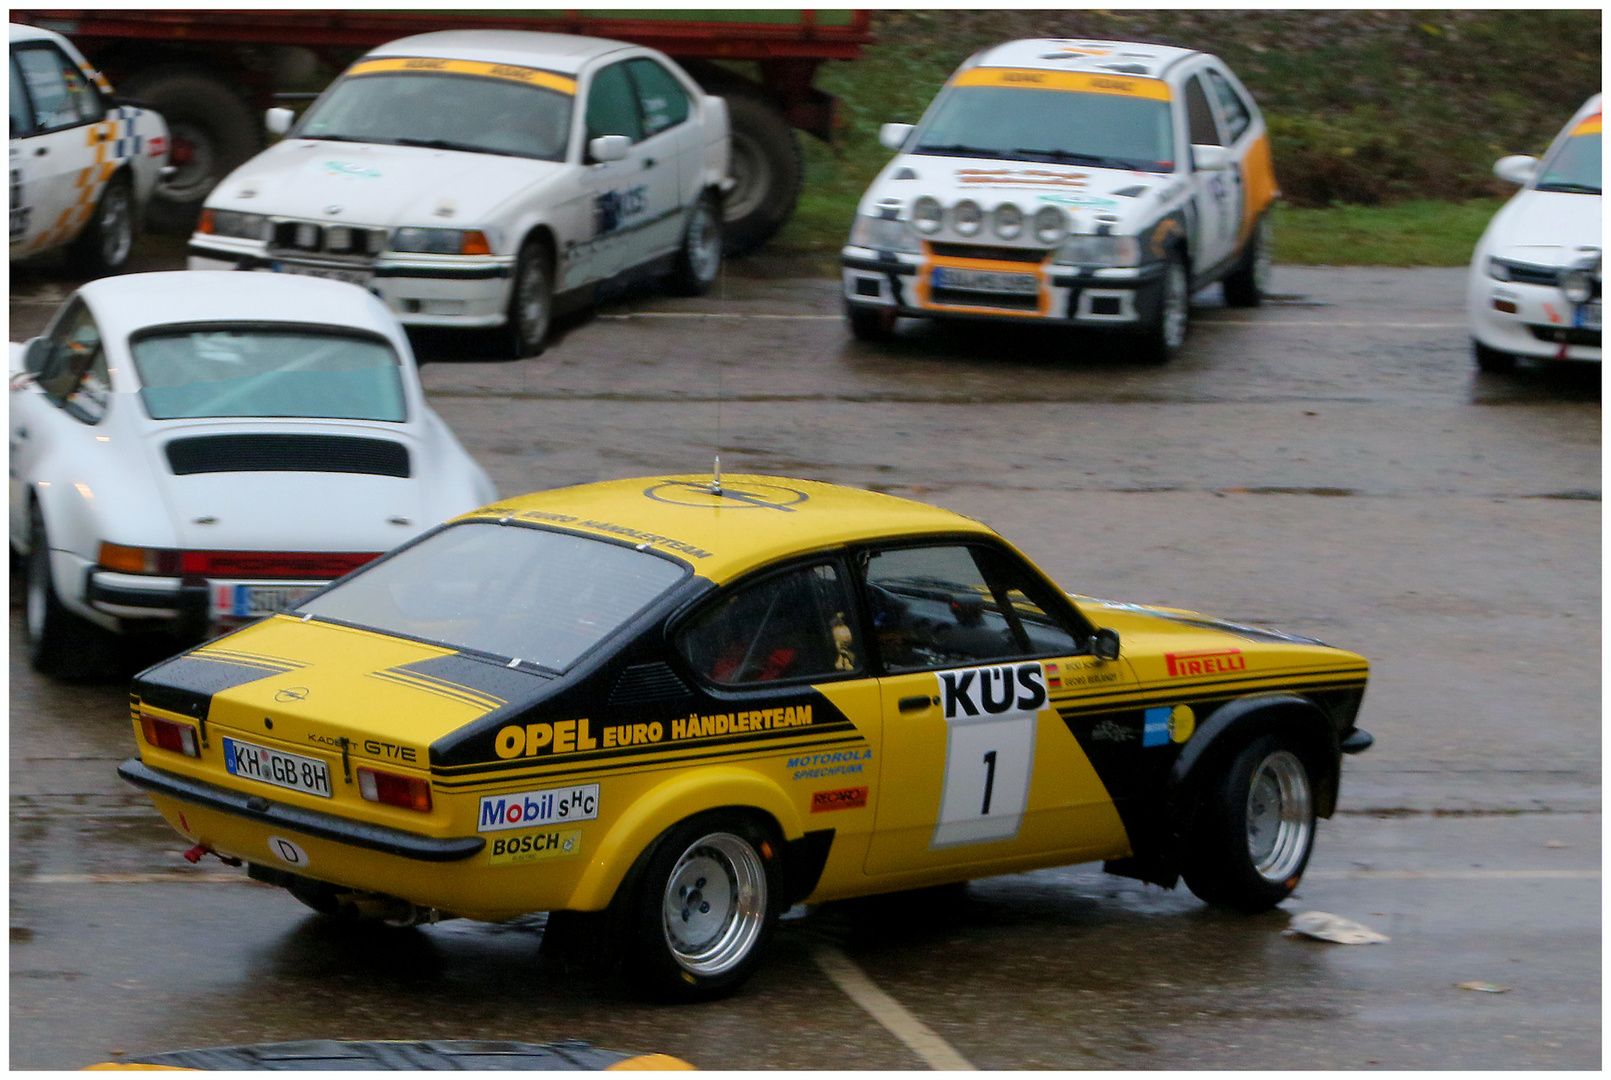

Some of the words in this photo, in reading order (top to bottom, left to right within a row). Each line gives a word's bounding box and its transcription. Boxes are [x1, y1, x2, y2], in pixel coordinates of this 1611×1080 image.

[1164, 648, 1246, 677] PIRELLI
[939, 662, 1047, 718] KÜS
[495, 718, 597, 760] OPEL
[603, 721, 664, 748] EURO
[671, 704, 813, 741] HÄNDLERTEAM
[307, 733, 359, 751] KADET
[363, 739, 417, 763] GT/E
[786, 749, 872, 769] MOTOROLA
[234, 745, 261, 777] KH
[271, 755, 299, 785] GB
[300, 762, 328, 793] 8H
[792, 764, 863, 781] SPRECHFUNK
[980, 750, 998, 816] 1
[481, 793, 554, 826] Mobil
[558, 790, 595, 817] SHC
[814, 788, 861, 804] RECARO
[277, 839, 299, 863] D
[492, 833, 560, 856] BOSCH
